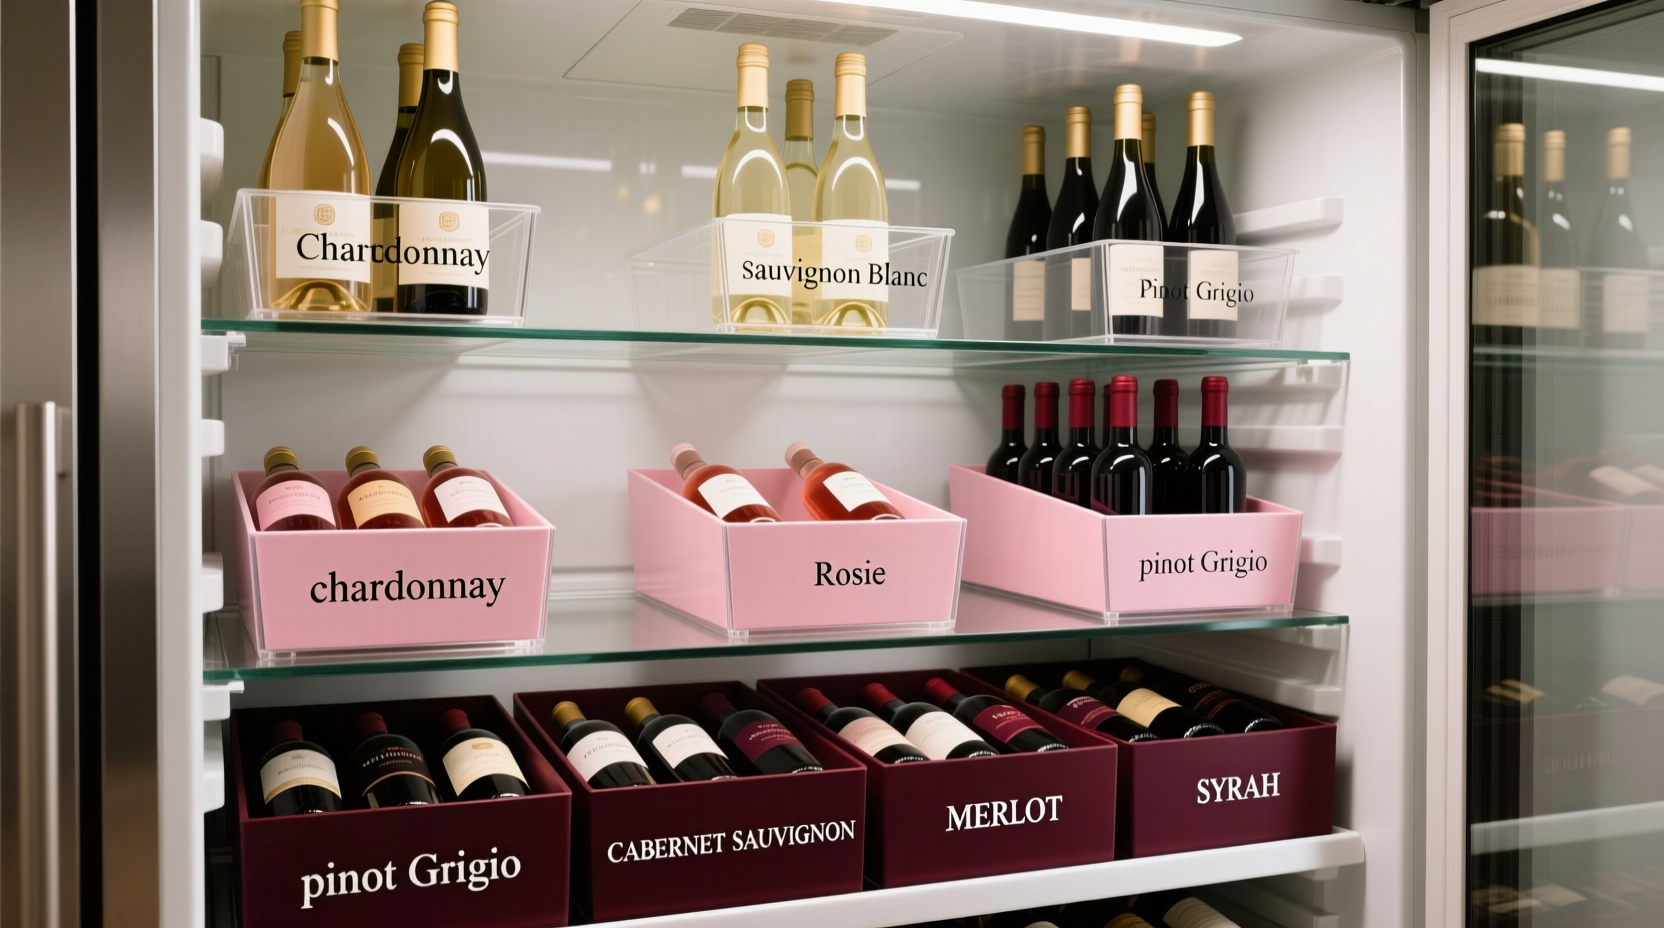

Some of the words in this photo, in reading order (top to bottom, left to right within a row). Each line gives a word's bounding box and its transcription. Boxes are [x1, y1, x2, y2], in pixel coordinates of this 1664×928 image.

[868, 262, 928, 287] Blanc
[1139, 278, 1189, 300] Pinot
[1196, 281, 1254, 308] Grigio
[815, 560, 886, 587] Rosie
[1139, 552, 1195, 582] pinot
[1201, 550, 1268, 579] Grigio
[310, 570, 506, 608] chardonnay
[1196, 772, 1281, 804] SYRAH
[945, 795, 1063, 832] MERLOT
[608, 833, 725, 863] CABERNET
[732, 820, 856, 852] SAUVIGNON
[301, 861, 397, 910] pinot
[408, 846, 522, 892] Grigio
